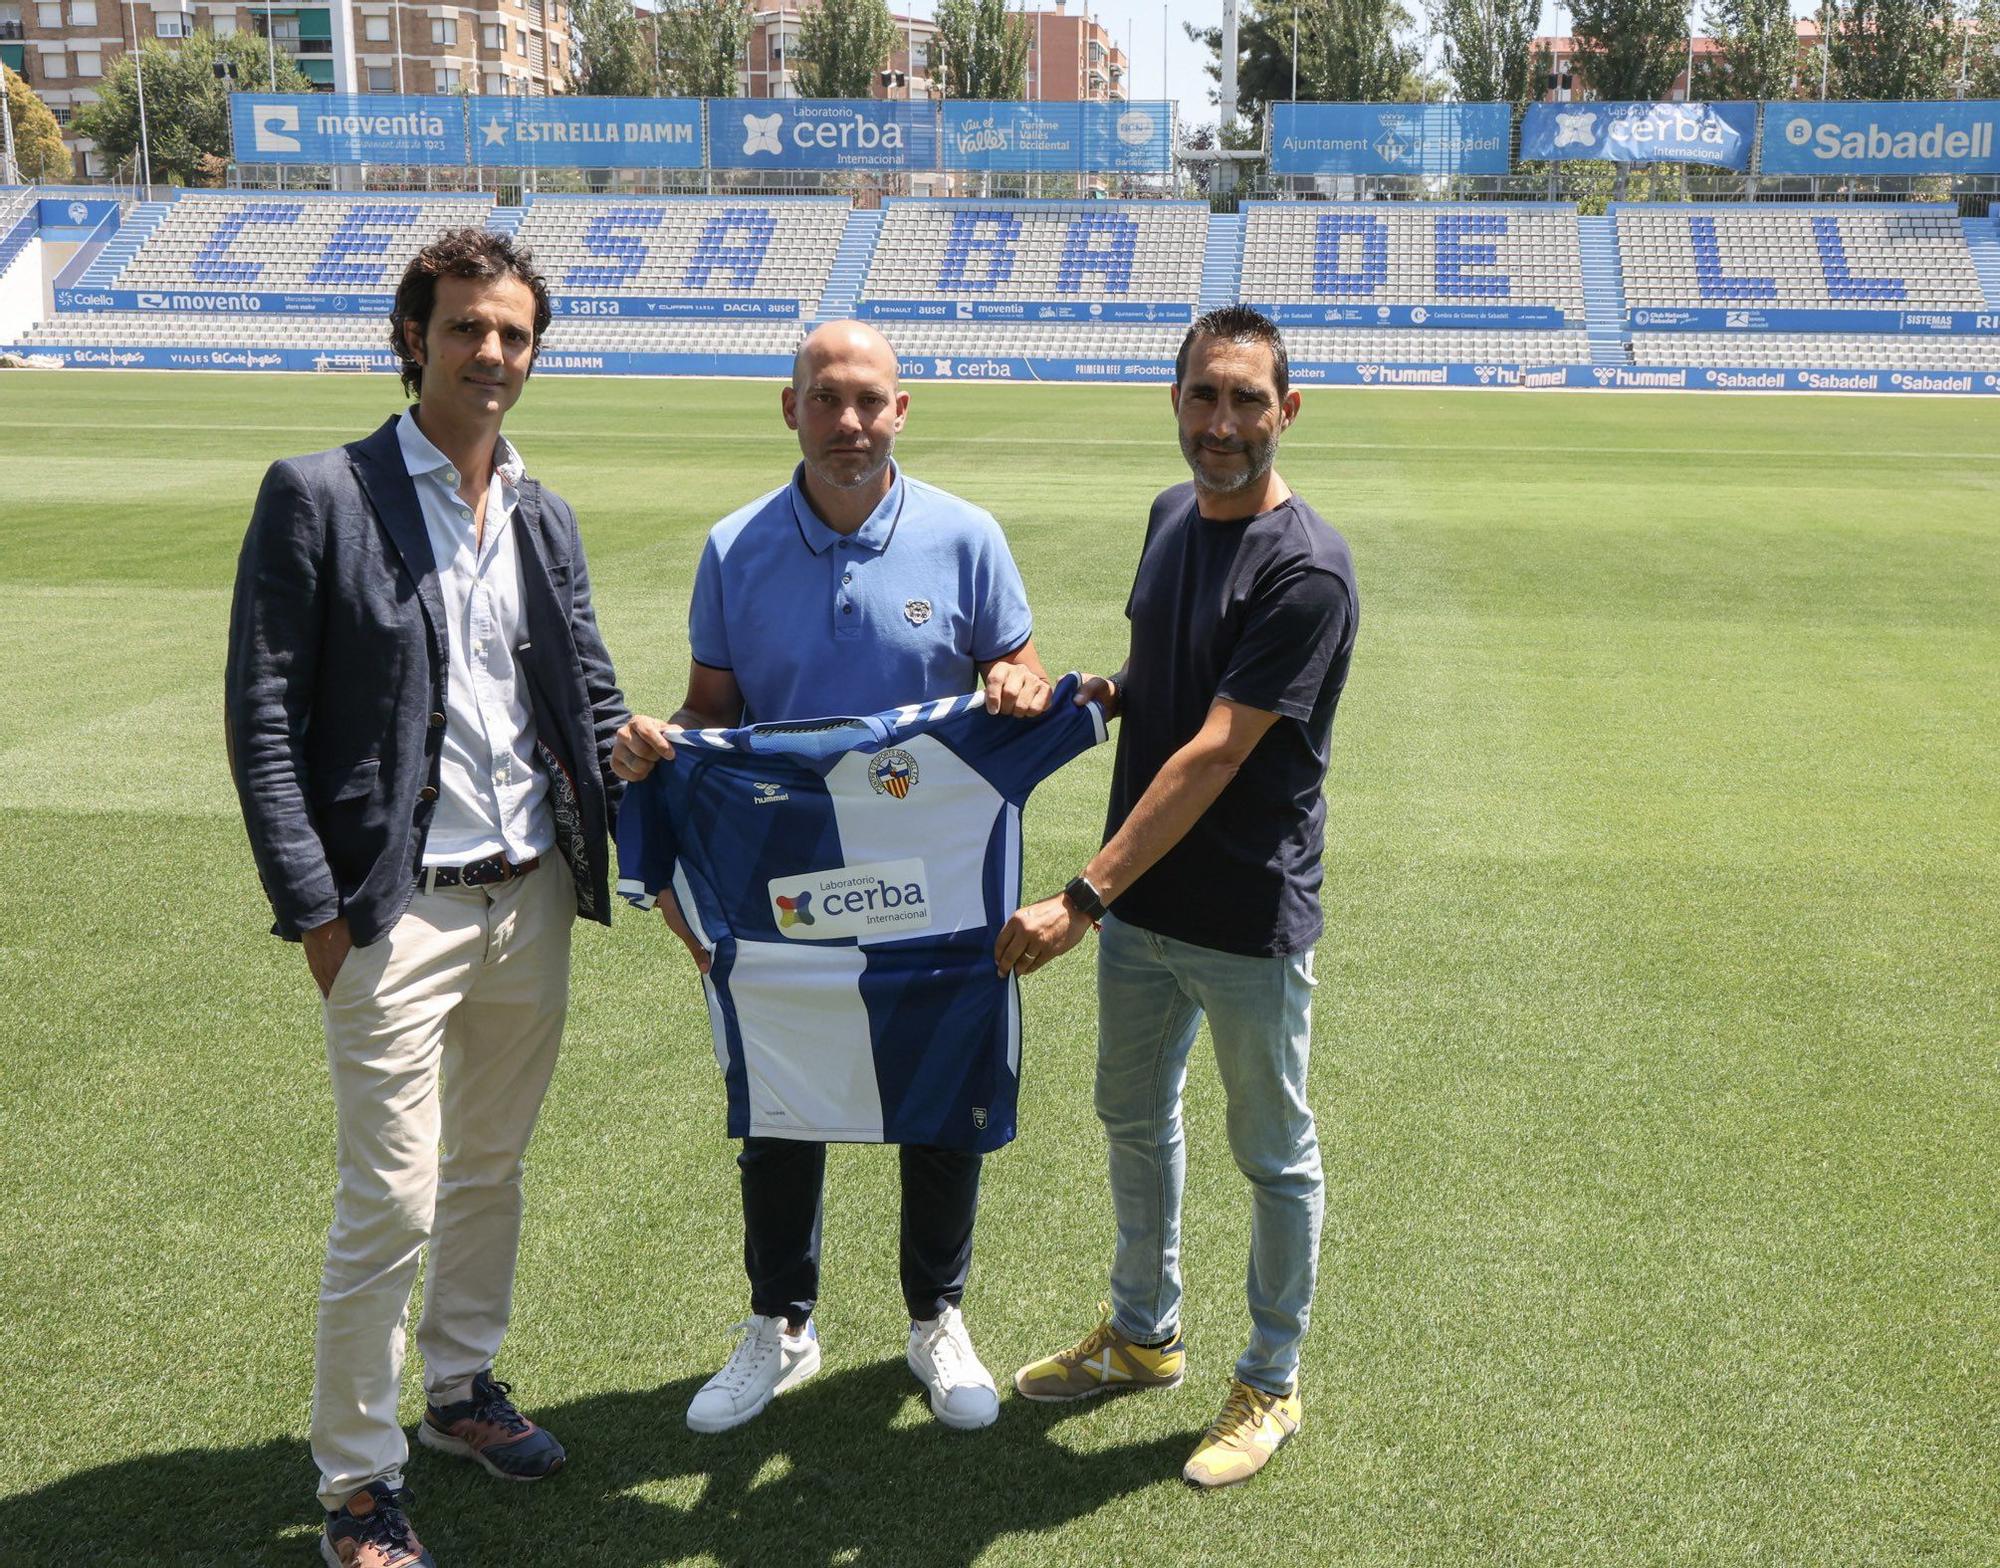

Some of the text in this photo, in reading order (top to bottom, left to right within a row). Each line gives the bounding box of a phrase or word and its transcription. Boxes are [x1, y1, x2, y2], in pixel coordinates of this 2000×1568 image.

[793, 106, 853, 118] Laboratorio
[316, 110, 445, 137] moventia
[1607, 108, 1725, 145] cerba
[515, 121, 693, 144] ESTRELLA DAMM
[793, 114, 904, 150] cerba
[423, 140, 446, 151] 1923
[1019, 140, 1070, 150] Occidental
[1283, 136, 1368, 151] Ajuntament
[1813, 122, 1993, 160] Sabadell
[837, 154, 904, 166] Internacional
[1653, 146, 1724, 161] Internacional
[173, 294, 261, 311] movento
[570, 300, 620, 315] sarsa
[723, 303, 762, 312] DACIA
[768, 304, 796, 313] auser
[918, 305, 947, 315] auser
[978, 303, 1024, 314] moventia
[1906, 314, 1953, 325] SISTEMAS
[1976, 315, 2000, 329] RI
[170, 353, 209, 364] VIAJES
[565, 356, 603, 369] DAMM
[957, 360, 1011, 377] cerba
[1379, 366, 1447, 383] hummel
[1616, 369, 1685, 387] hummel
[1716, 373, 1785, 388] Sabadell
[1808, 374, 1878, 389] Sabadell
[1901, 376, 1972, 391] Sabadell
[753, 793, 789, 805] hummel
[820, 876, 875, 891] Laboratorio
[823, 880, 925, 916] cerba
[866, 909, 928, 925] Internacional
